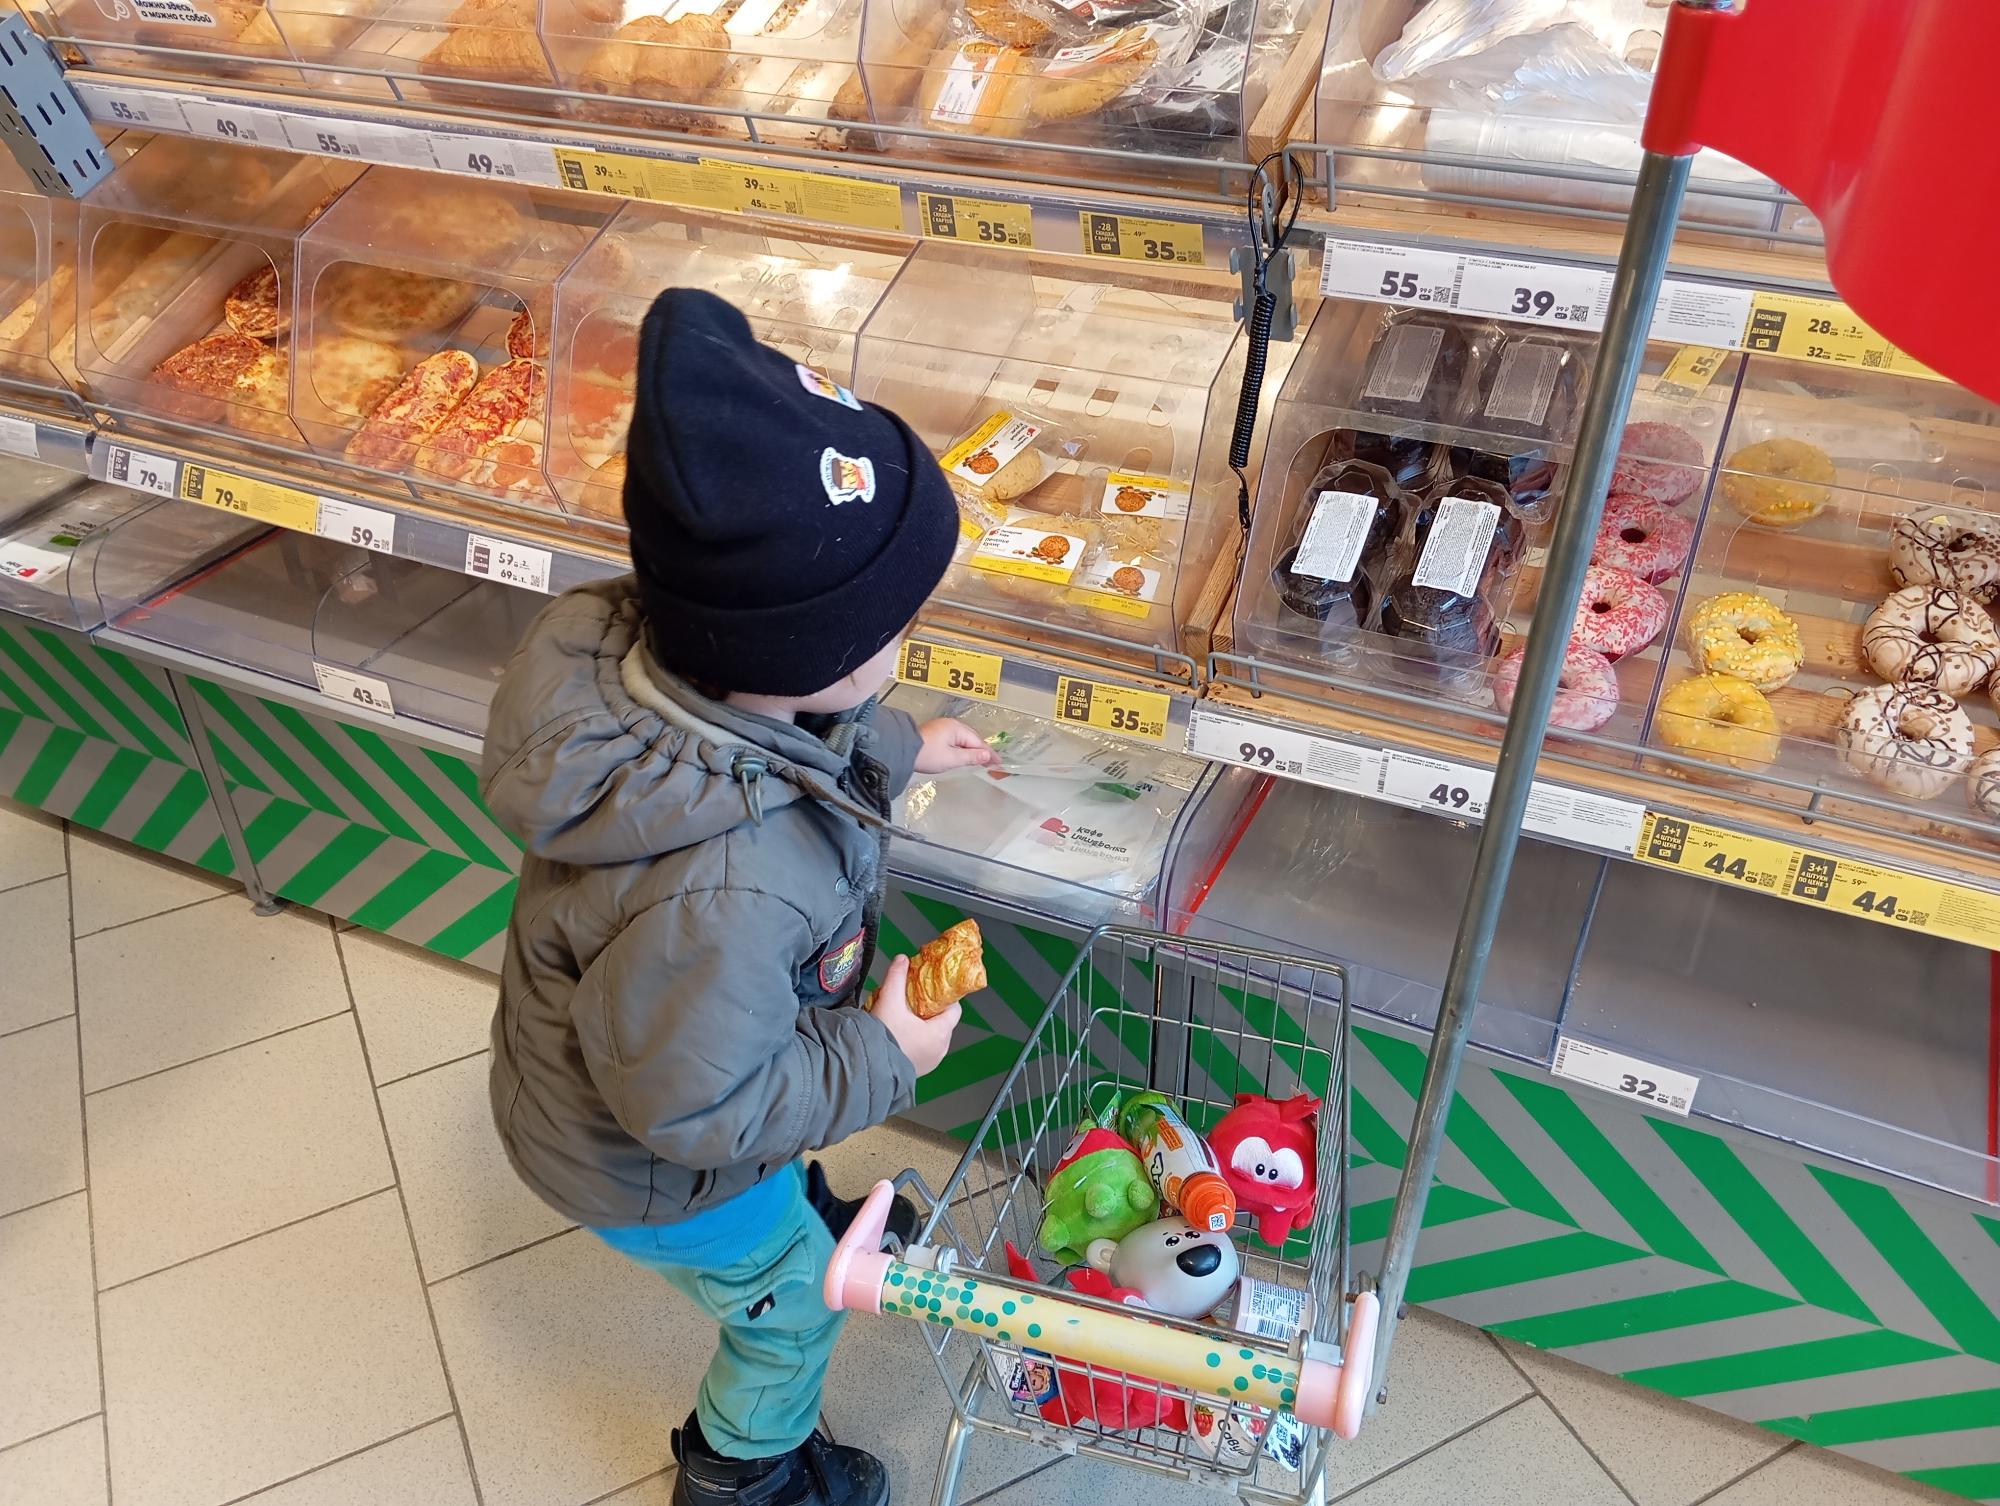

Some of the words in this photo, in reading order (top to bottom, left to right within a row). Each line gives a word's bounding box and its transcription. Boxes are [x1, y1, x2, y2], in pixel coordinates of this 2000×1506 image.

[150, 11, 178, 20] можно
[186, 13, 212, 23] собой
[110, 101, 133, 121] 55
[216, 118, 238, 138] 49
[316, 133, 342, 153] 55
[467, 152, 493, 173] 49
[594, 165, 607, 177] 39
[744, 177, 758, 190] 39
[751, 199, 761, 208] 45
[977, 220, 1007, 243] 35
[1143, 239, 1175, 260] 35
[1380, 270, 1419, 299] 55
[1511, 287, 1555, 316] 39
[1807, 318, 1831, 335] 28
[1806, 346, 1824, 359] 32
[1690, 356, 1715, 377] 55
[140, 469, 157, 488] 79
[215, 488, 234, 507] 79
[351, 526, 373, 546] 59
[498, 552, 514, 566] 59
[500, 569, 512, 580] 69
[913, 650, 925, 658] -28
[948, 668, 975, 691] 35
[352, 686, 374, 705] 43
[1073, 689, 1085, 697] -28
[1111, 707, 1140, 731] 35
[1239, 742, 1275, 767] 99
[1429, 783, 1470, 809] 49
[1660, 834, 1682, 844] ШТУКИ
[1662, 825, 1680, 837] 3+1
[1704, 852, 1747, 880] 44
[1807, 862, 1828, 875] 3+1
[1806, 872, 1829, 882] ШТУКИ
[1852, 890, 1898, 918] 44
[1619, 1074, 1657, 1100] 32
